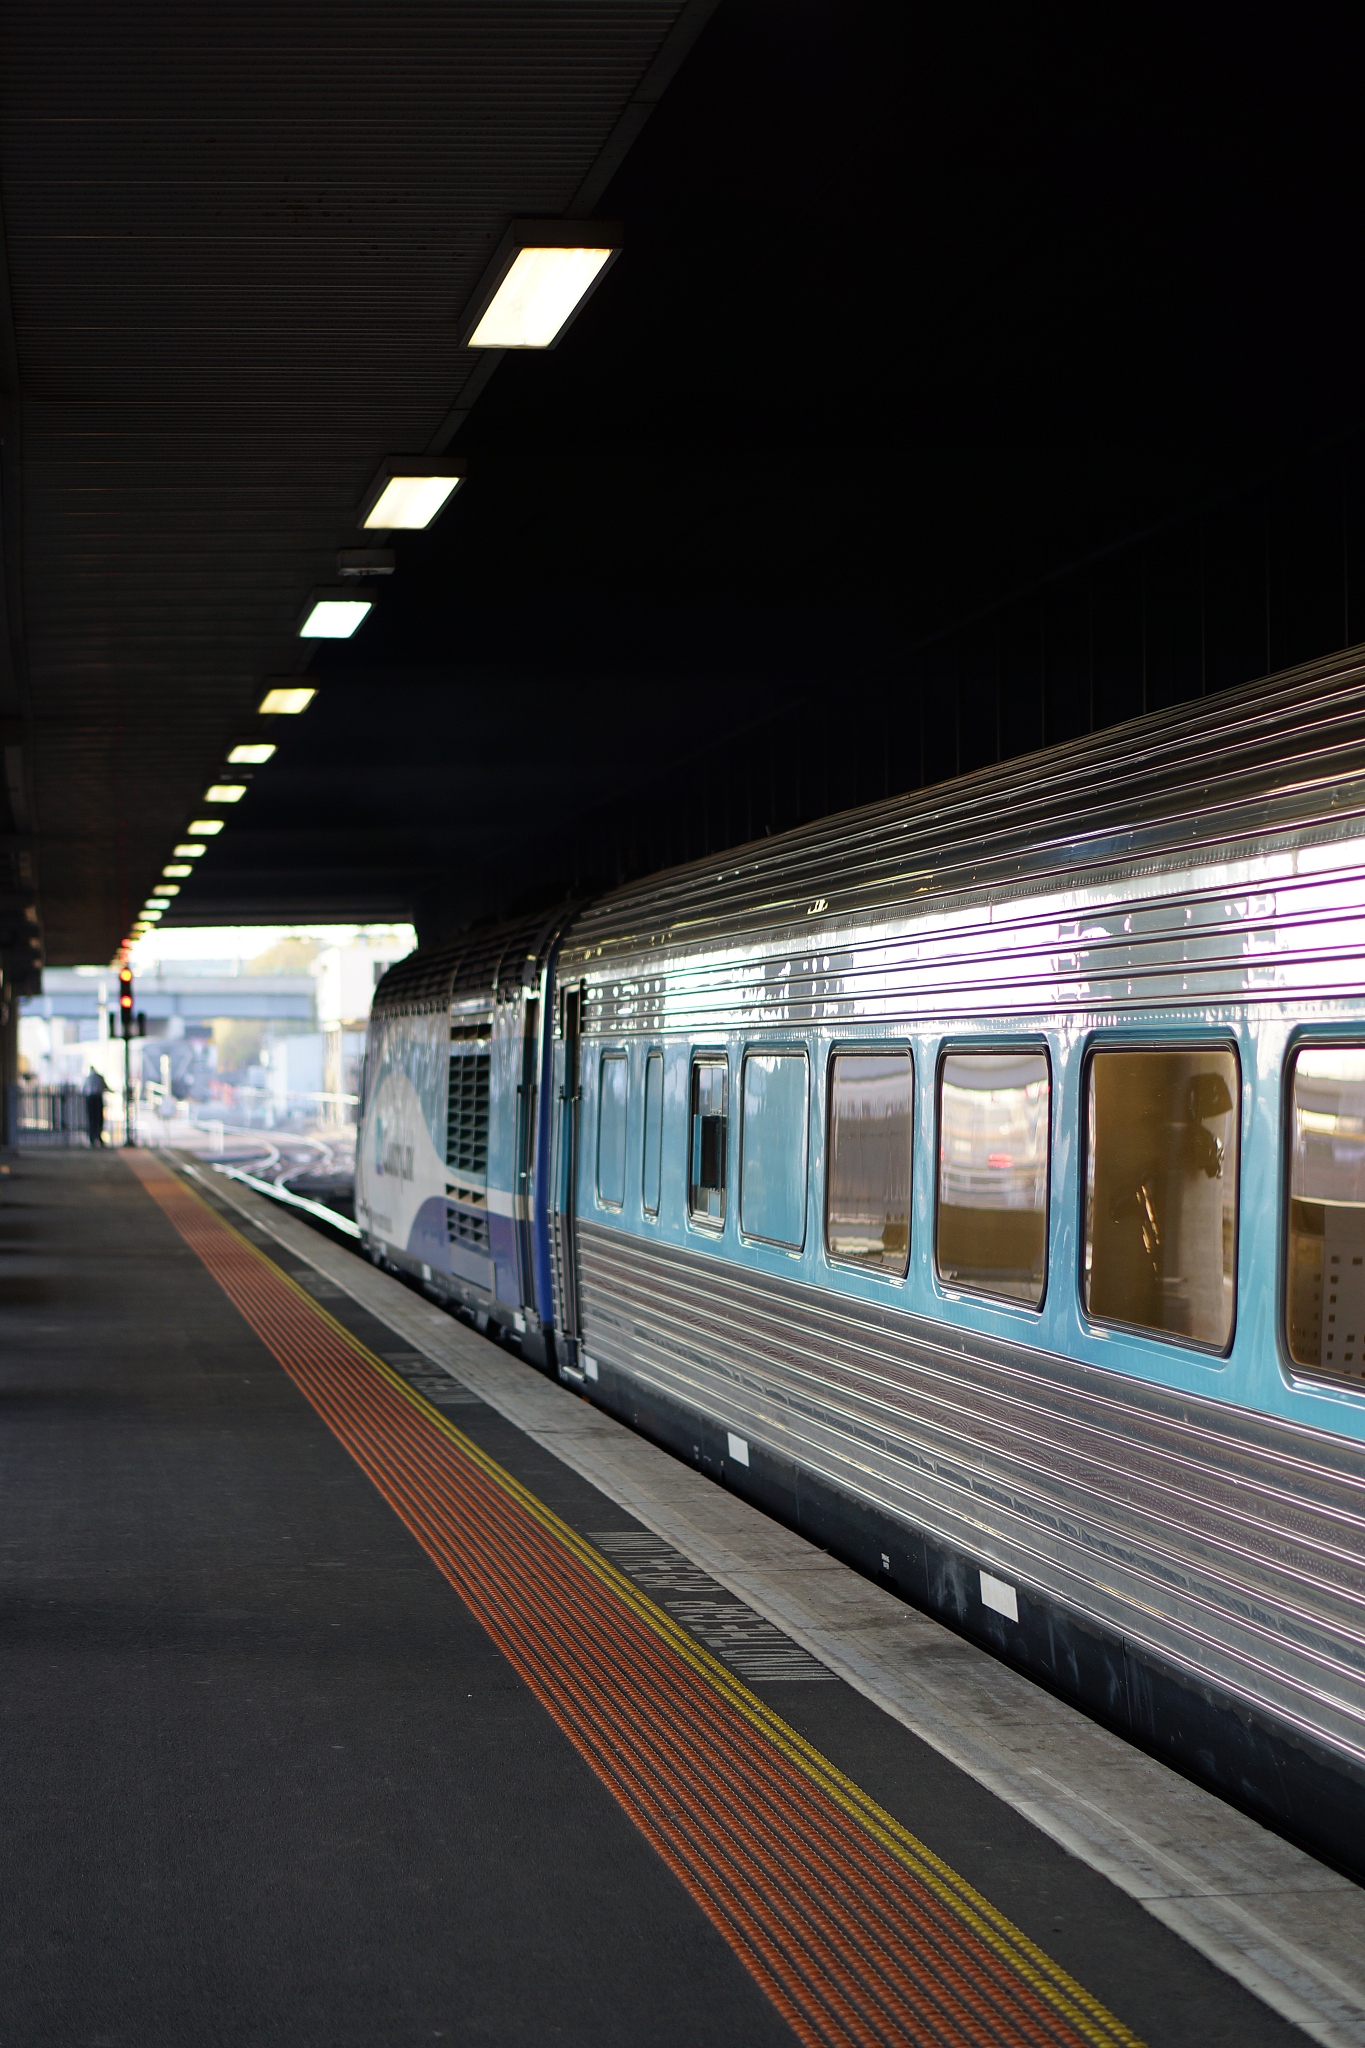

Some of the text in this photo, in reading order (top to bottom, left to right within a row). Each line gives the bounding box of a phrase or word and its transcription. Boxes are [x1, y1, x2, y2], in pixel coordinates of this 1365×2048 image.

[586, 1531, 729, 1592] MIND THE GAP
[664, 1600, 840, 1681] MIND THE GAP
